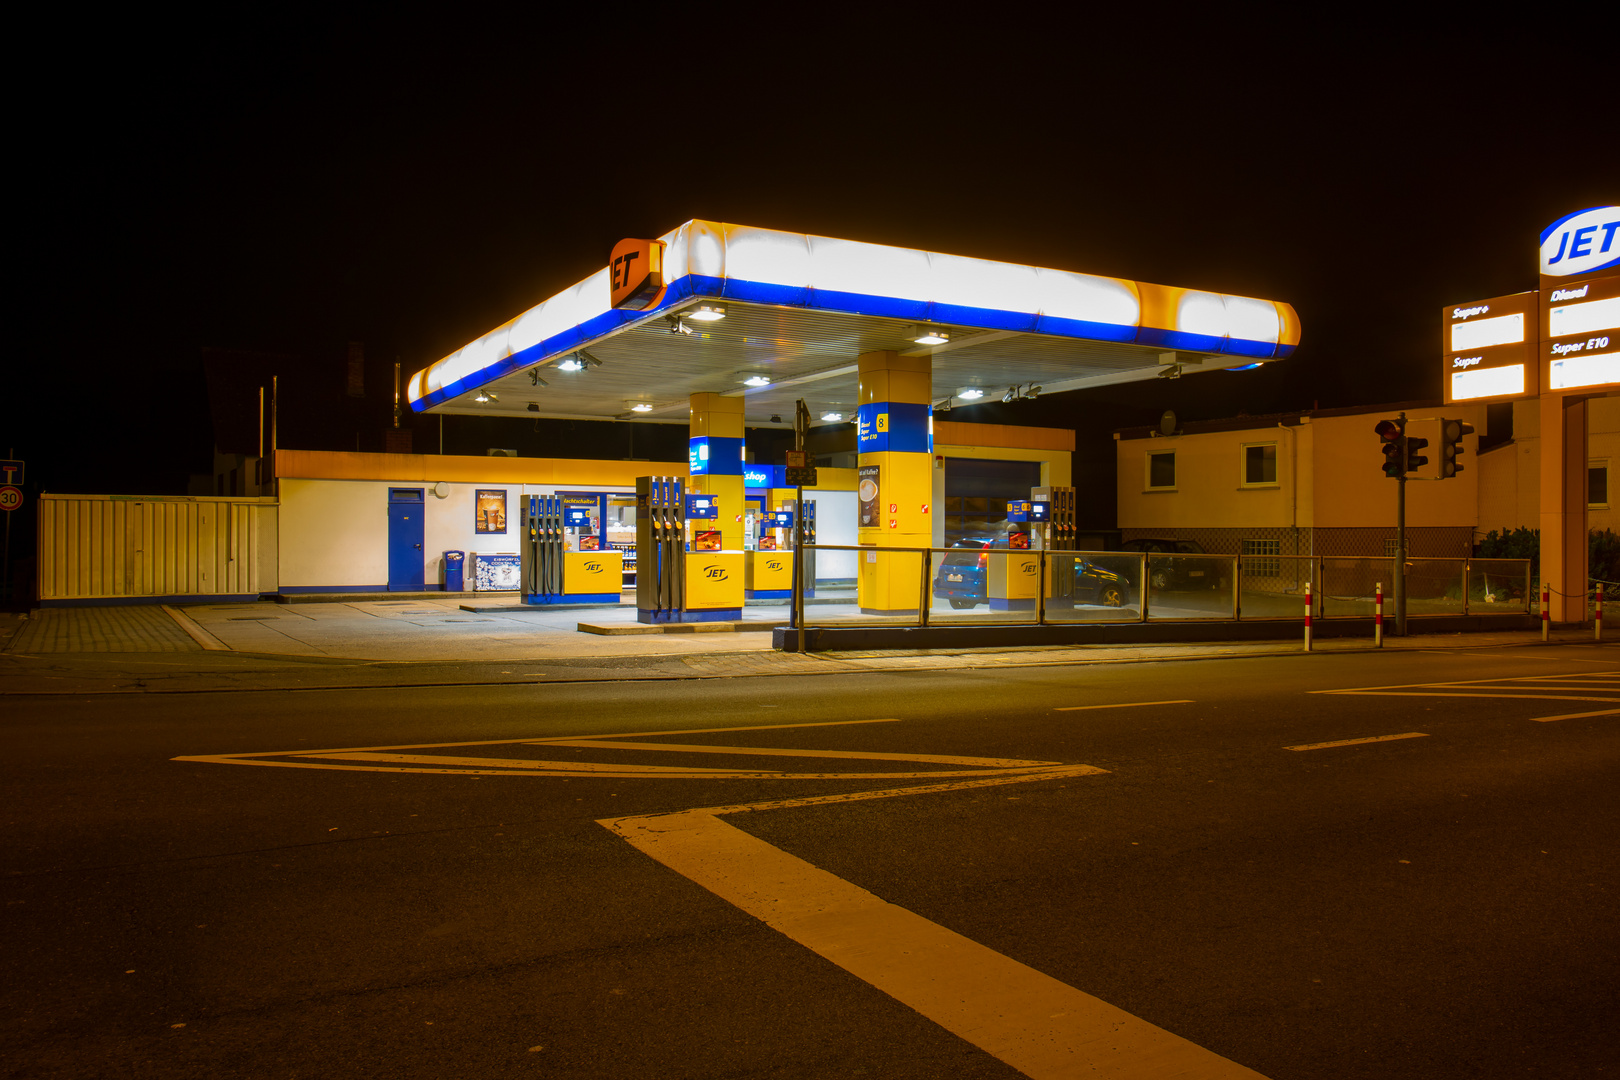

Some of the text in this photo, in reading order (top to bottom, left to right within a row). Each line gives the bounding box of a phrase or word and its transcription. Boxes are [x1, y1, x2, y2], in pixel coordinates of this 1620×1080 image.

[1547, 221, 1620, 266] JET
[1550, 284, 1589, 302] Diesel
[1452, 305, 1490, 320] Super+
[1550, 336, 1610, 356] Super E10
[1452, 356, 1483, 369] Super
[878, 418, 884, 428] 8
[1, 493, 17, 503] 30
[706, 569, 726, 578] JET
[1022, 565, 1037, 573] JET
